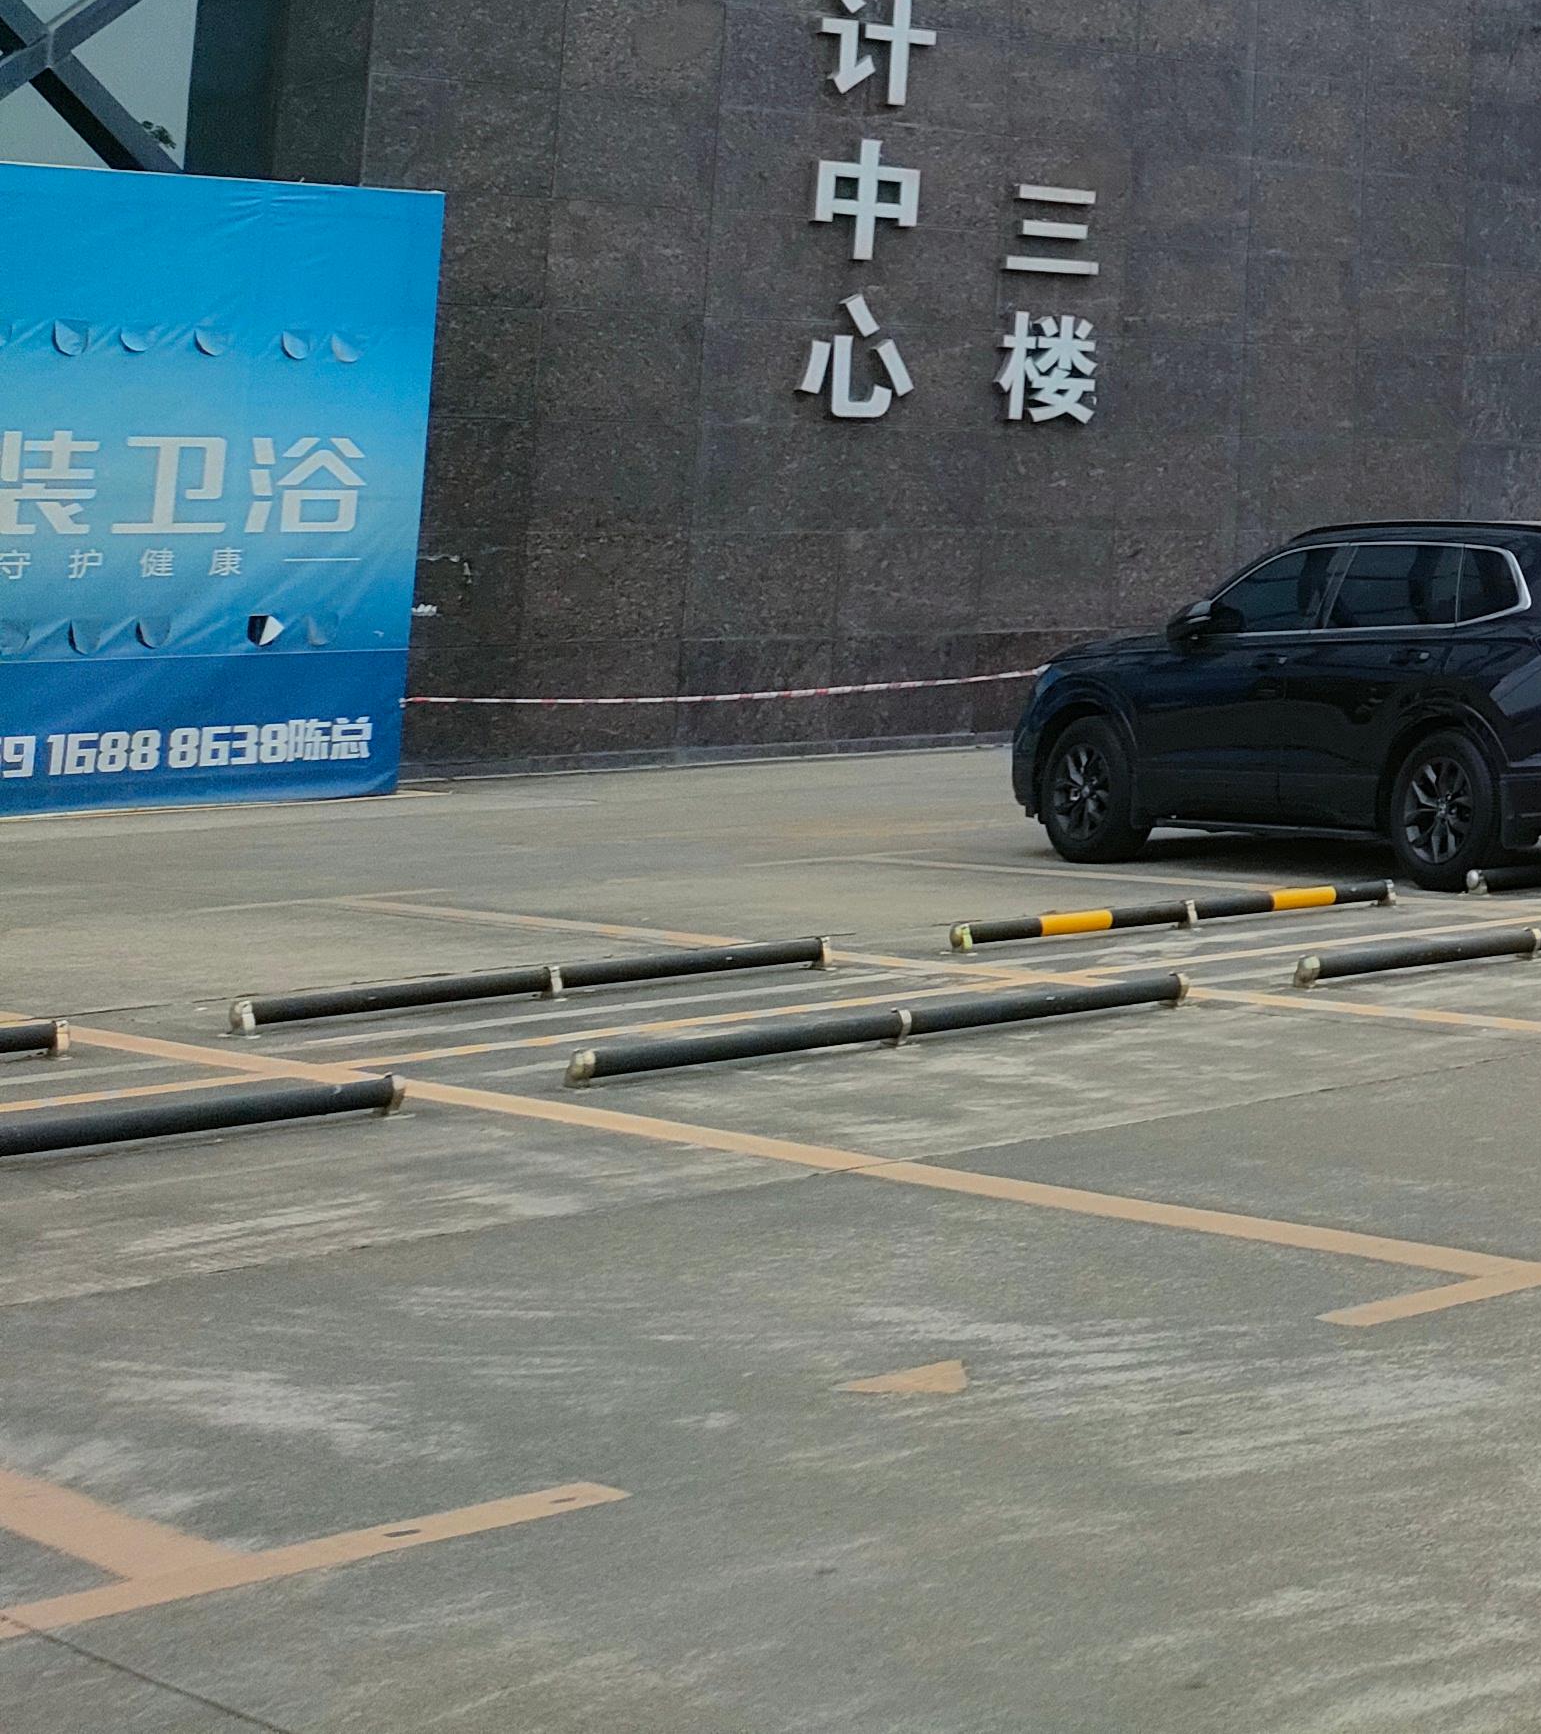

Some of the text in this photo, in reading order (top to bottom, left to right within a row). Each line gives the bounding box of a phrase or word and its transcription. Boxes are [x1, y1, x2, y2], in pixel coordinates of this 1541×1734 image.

[997, 183, 1100, 423] 三楼
[0, 431, 366, 534] 装卫浴
[0, 547, 243, 579] 守护健康
[0, 716, 373, 779] 9 1688 8638陈总
